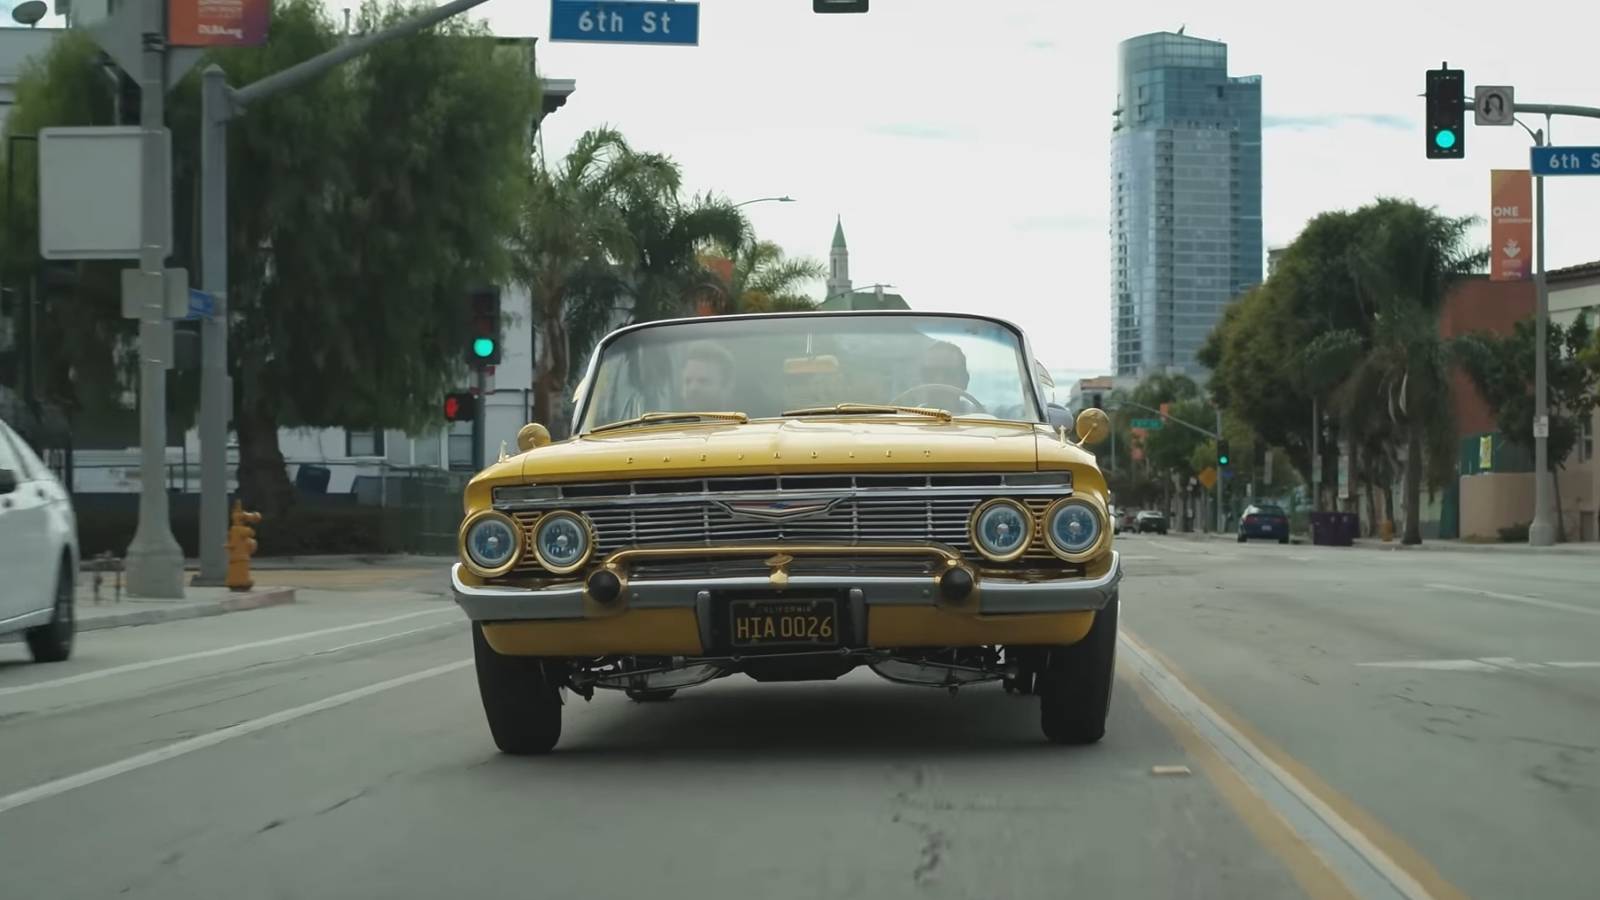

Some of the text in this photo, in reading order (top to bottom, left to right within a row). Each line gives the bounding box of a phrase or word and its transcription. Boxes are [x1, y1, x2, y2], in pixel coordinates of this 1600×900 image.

[578, 10, 671, 34] 6th St
[1549, 153, 1580, 169] 6th
[1492, 206, 1519, 217] ONE
[737, 616, 832, 638] HIA 0026
